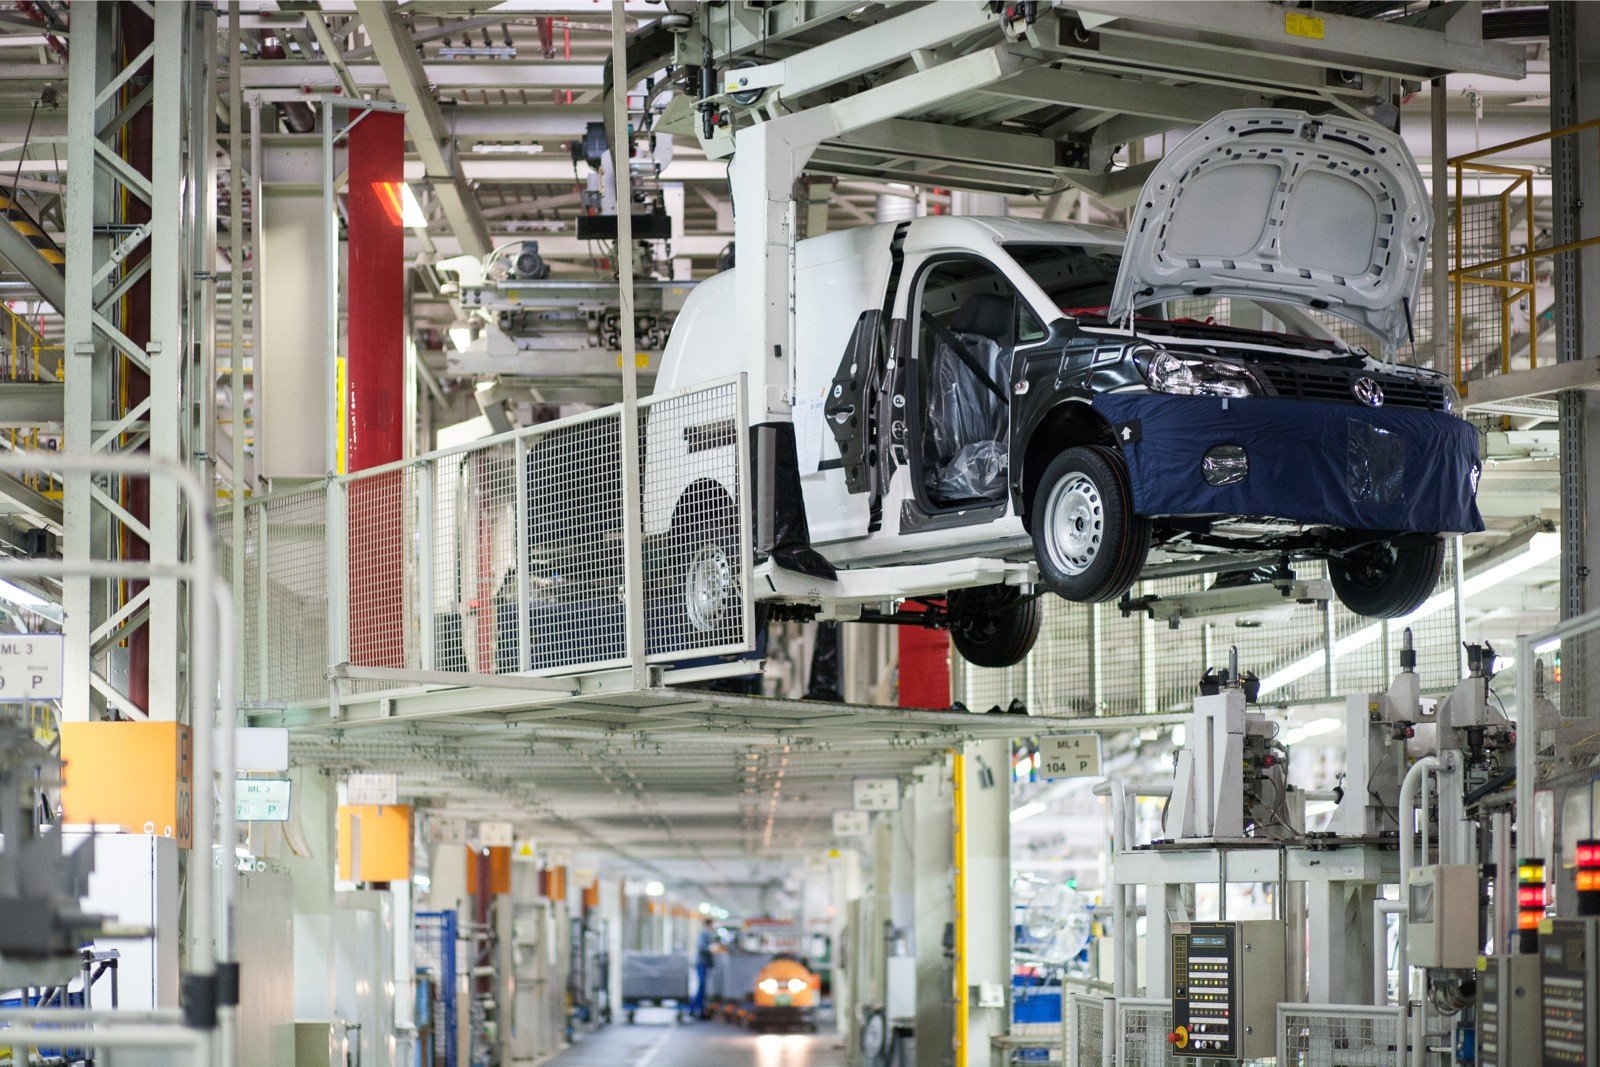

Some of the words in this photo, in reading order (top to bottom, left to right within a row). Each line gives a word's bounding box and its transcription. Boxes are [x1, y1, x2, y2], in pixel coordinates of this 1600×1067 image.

[0, 643, 20, 655] ML
[25, 643, 33, 655] 3
[32, 675, 43, 689] P
[1057, 740, 1072, 749] ML
[1074, 740, 1080, 748] 4
[1046, 762, 1066, 773] 104
[1080, 761, 1088, 771] P
[268, 805, 276, 814] P
